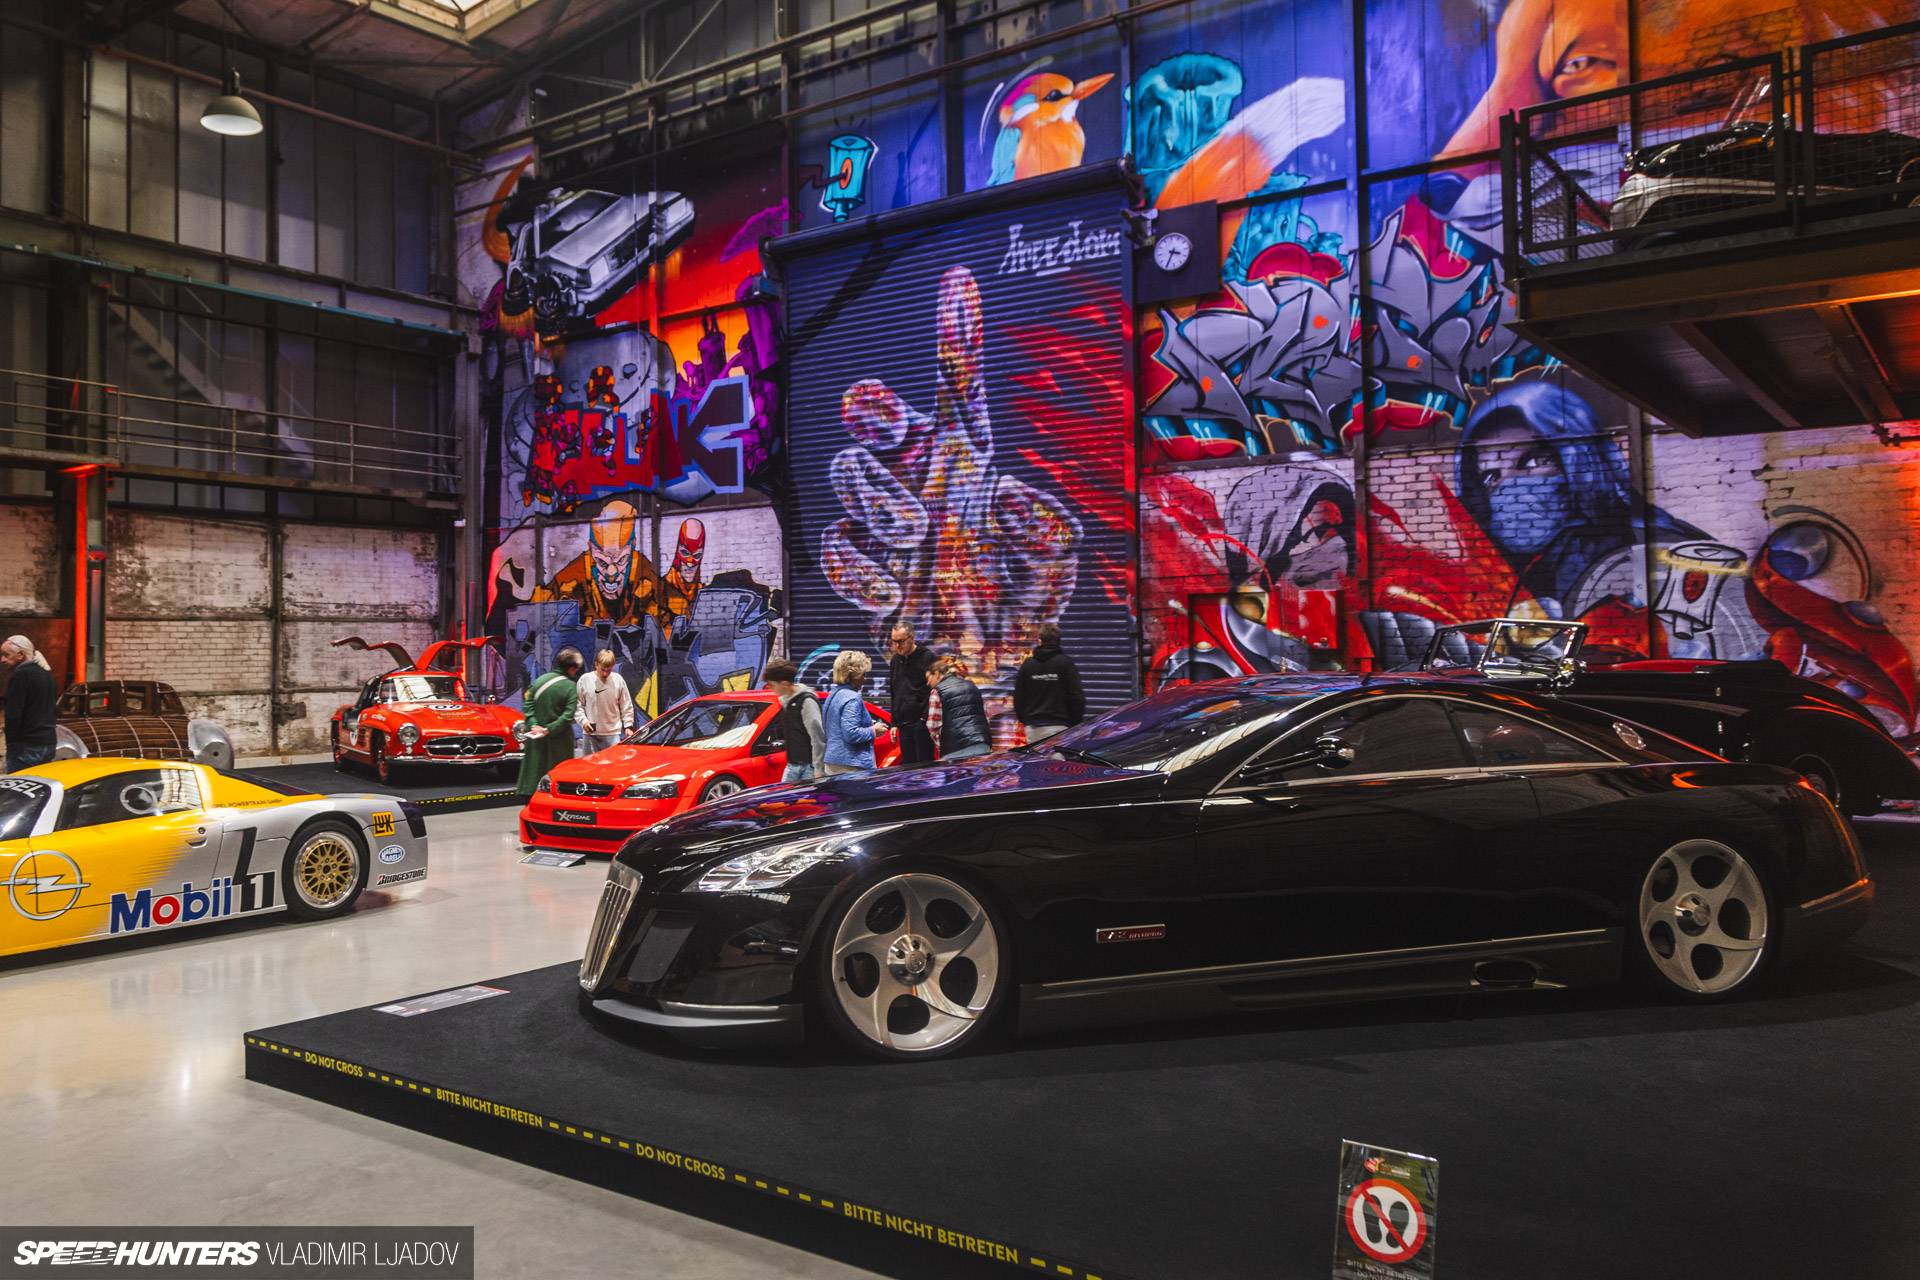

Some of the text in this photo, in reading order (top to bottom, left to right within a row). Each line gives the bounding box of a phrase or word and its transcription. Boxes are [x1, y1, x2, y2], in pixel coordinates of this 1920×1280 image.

[377, 868, 425, 885] BRIDGESTONE
[110, 876, 231, 933] Mobil
[304, 1051, 363, 1078] DO NOT CROSS
[437, 1087, 543, 1128] BITTE NICHT BETRETEN
[636, 1143, 726, 1181] DO NOT CROSS
[843, 1202, 1019, 1265] BITTE NICHT BETRETEN
